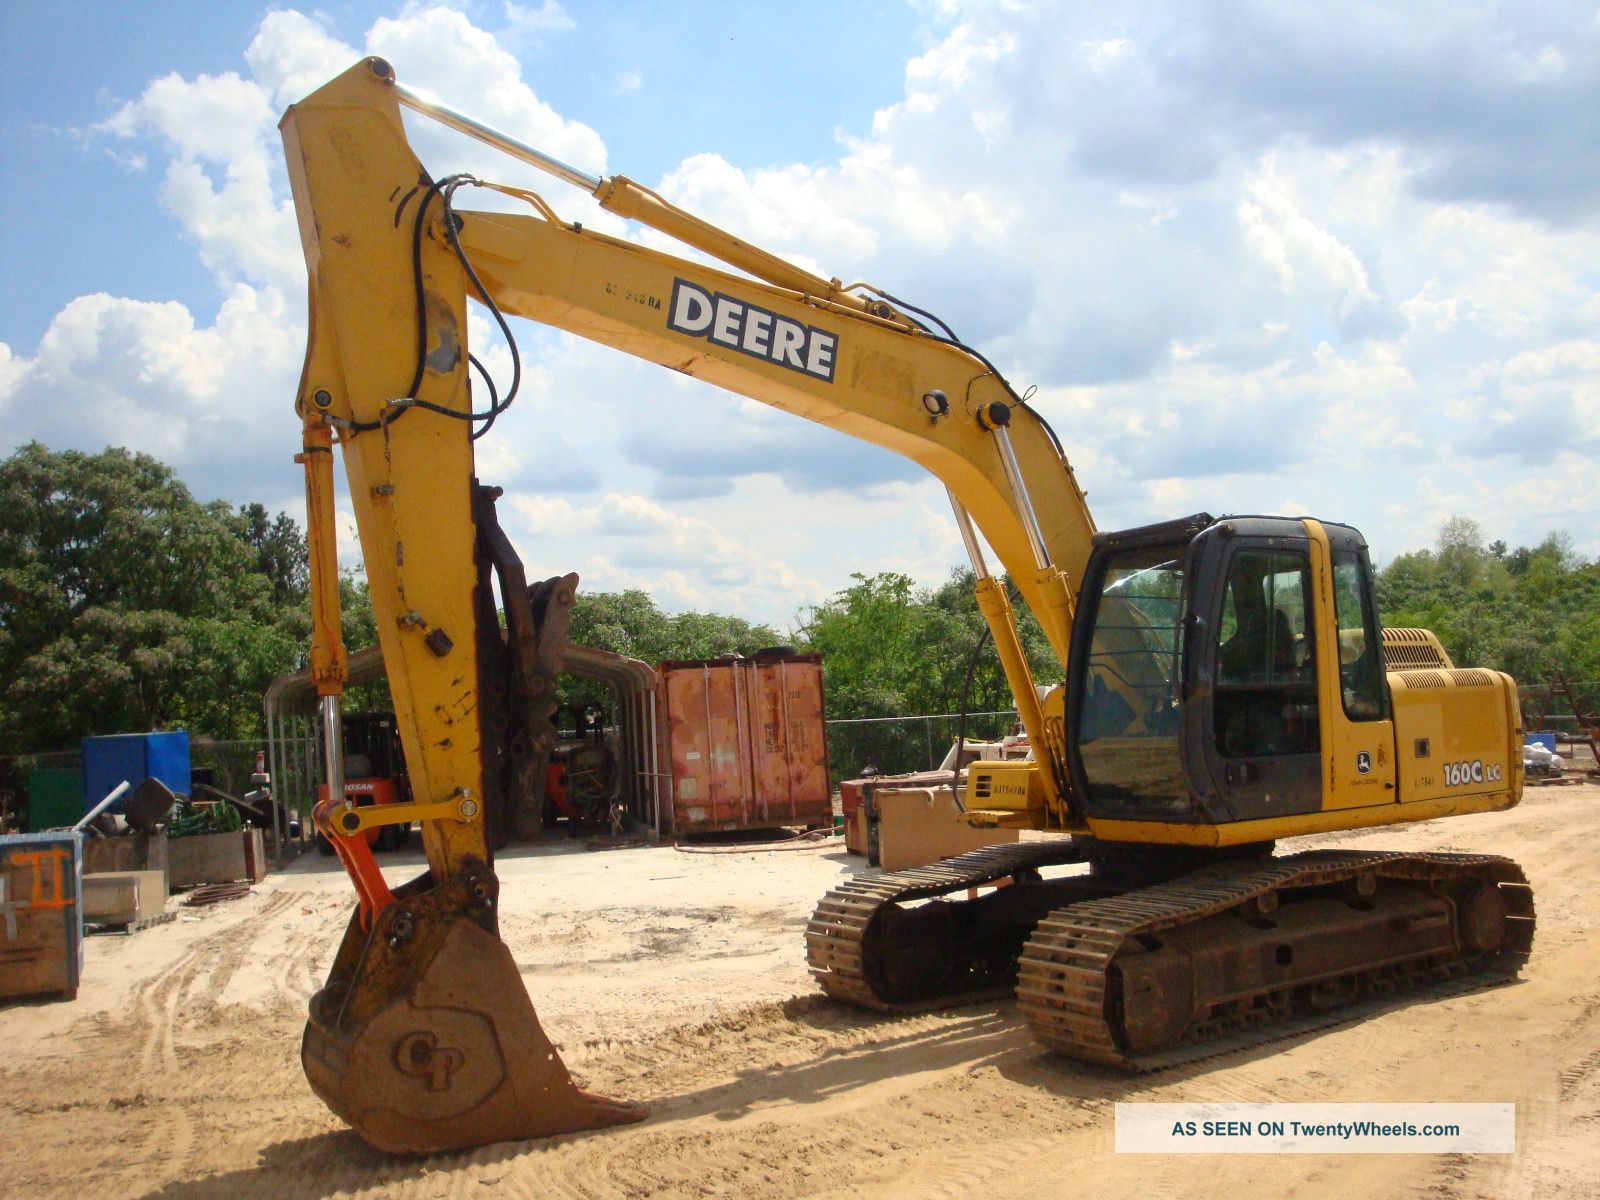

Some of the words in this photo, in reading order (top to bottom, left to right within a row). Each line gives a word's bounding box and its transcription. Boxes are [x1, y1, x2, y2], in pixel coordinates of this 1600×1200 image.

[673, 283, 835, 377] DEERE
[1443, 760, 1483, 787] 160C
[1487, 764, 1502, 782] LC
